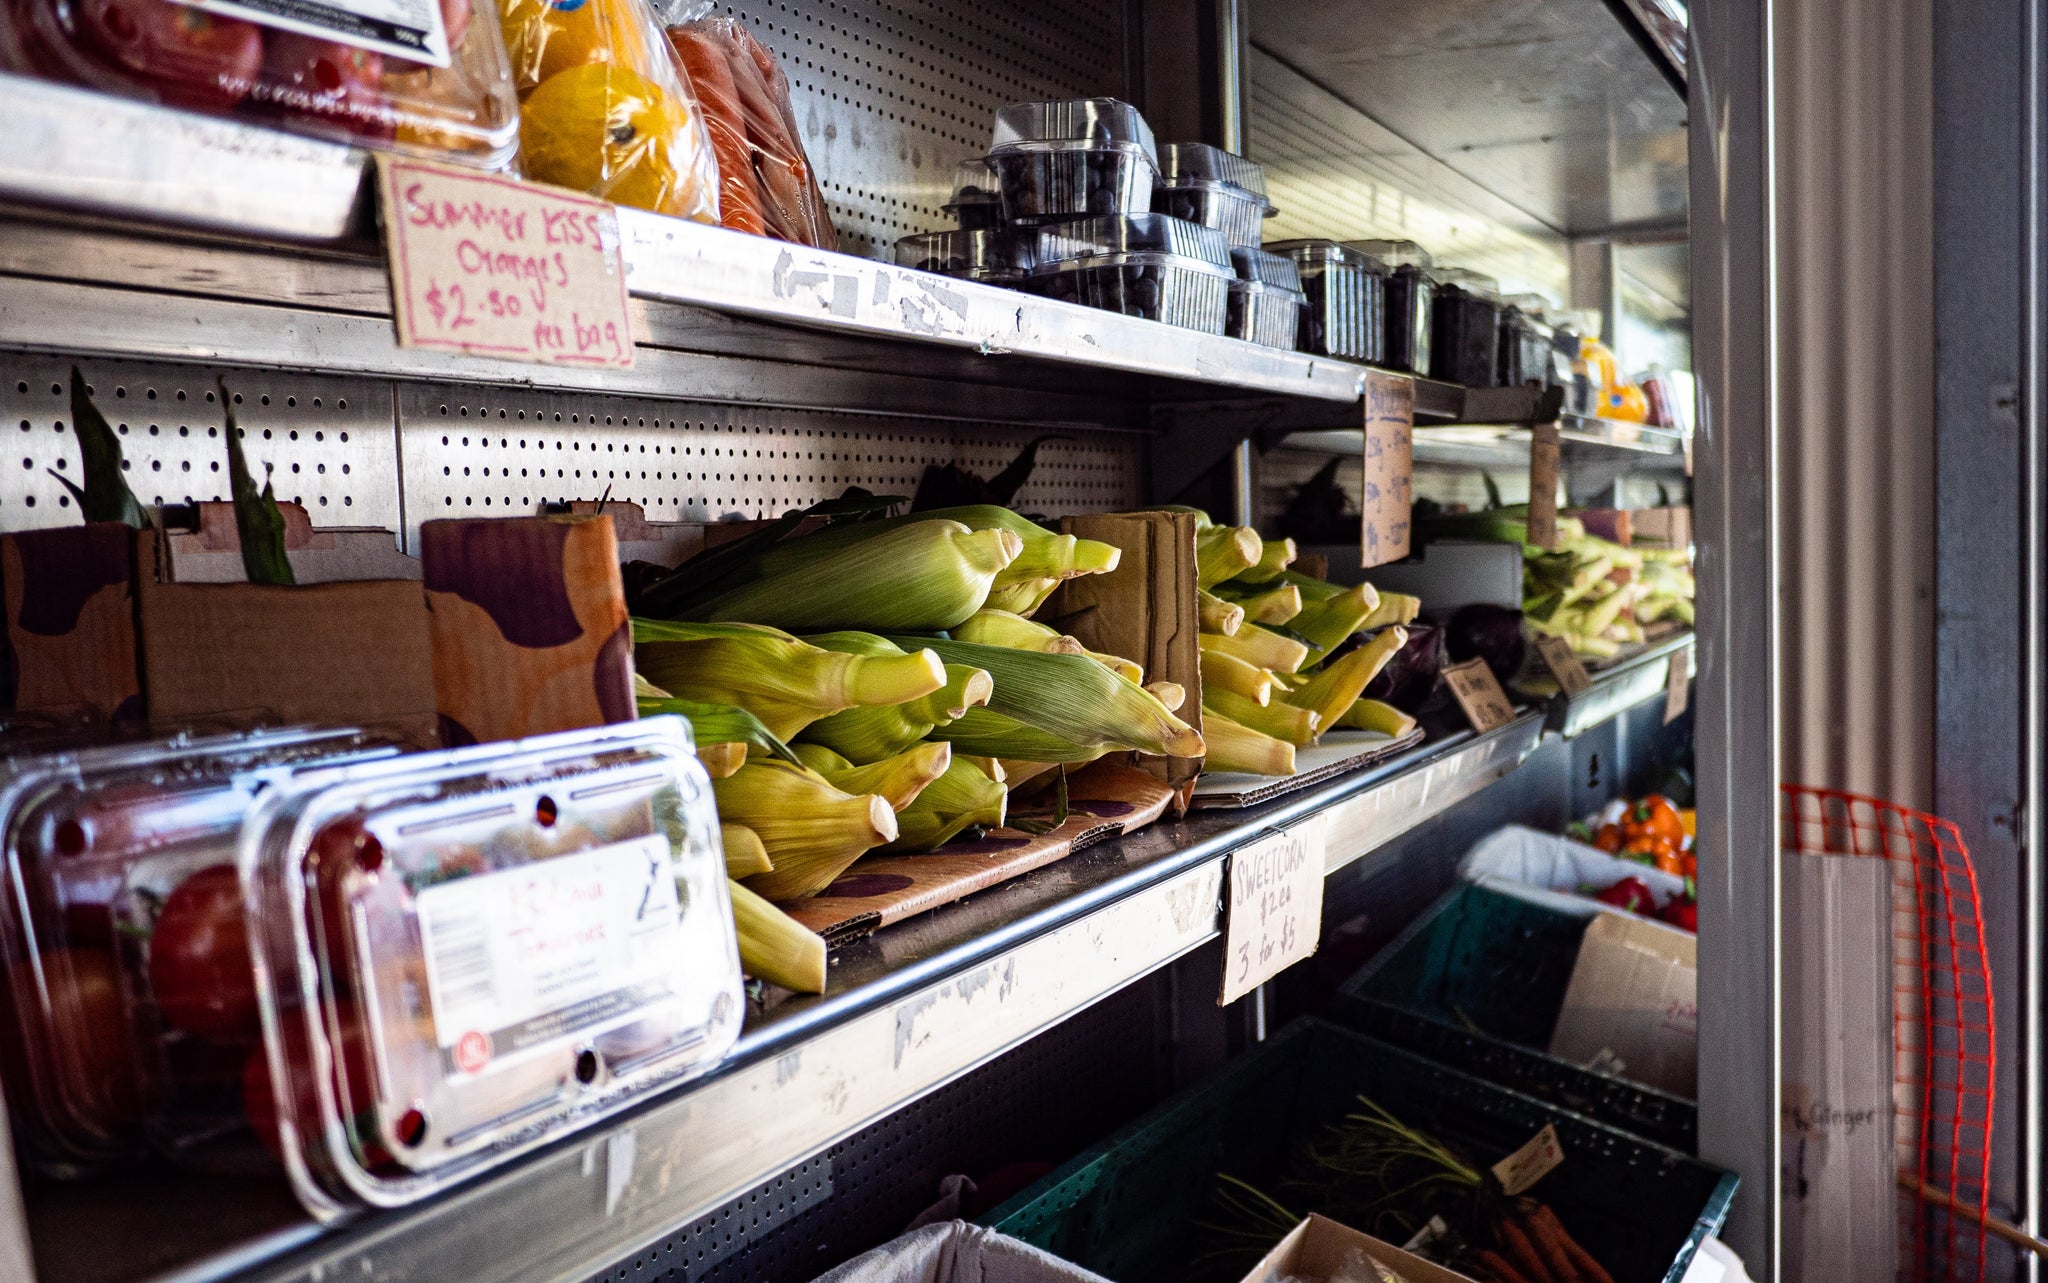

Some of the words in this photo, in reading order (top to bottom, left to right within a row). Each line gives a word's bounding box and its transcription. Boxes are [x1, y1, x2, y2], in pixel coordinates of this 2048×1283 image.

[406, 183, 526, 242] Summer
[457, 240, 568, 312] Oranges
[572, 312, 622, 362] bag
[1236, 832, 1308, 907] SWEETCORN
[1238, 940, 1250, 984] 3
[1259, 932, 1275, 966] for
[1281, 914, 1296, 956] $5
